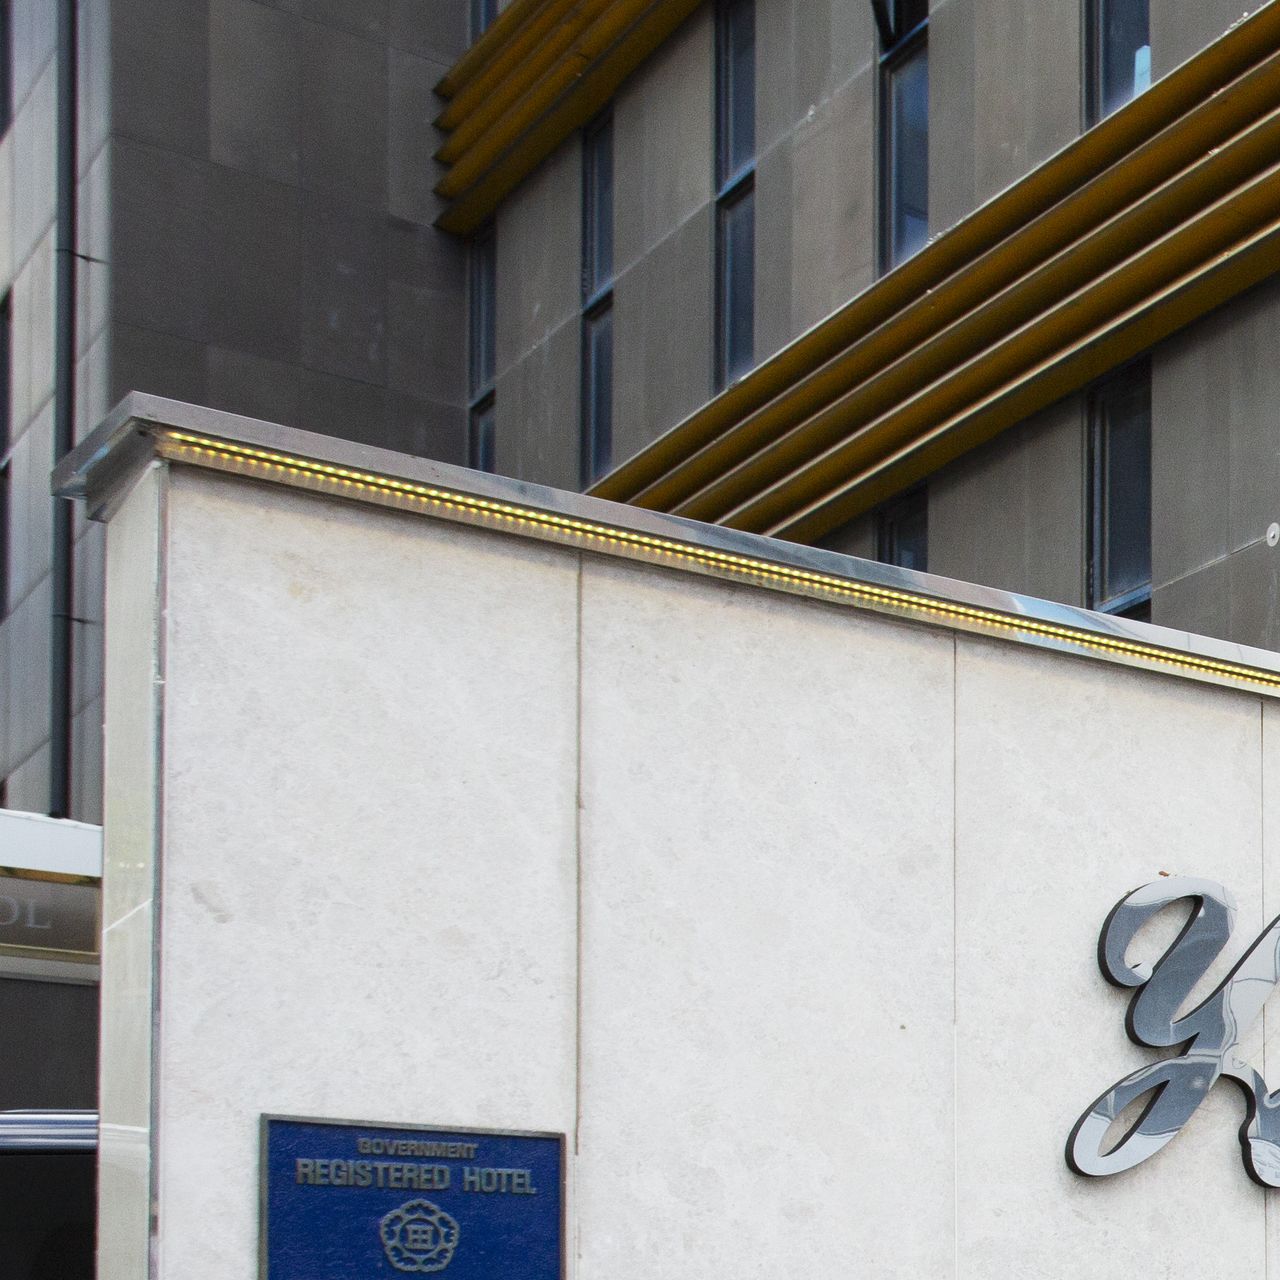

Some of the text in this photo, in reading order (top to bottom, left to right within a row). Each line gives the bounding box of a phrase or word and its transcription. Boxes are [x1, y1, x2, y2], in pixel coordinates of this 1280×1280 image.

[357, 1137, 479, 1159] GOVERNMENT
[295, 1157, 537, 1194] REGISTERED HOTEL
